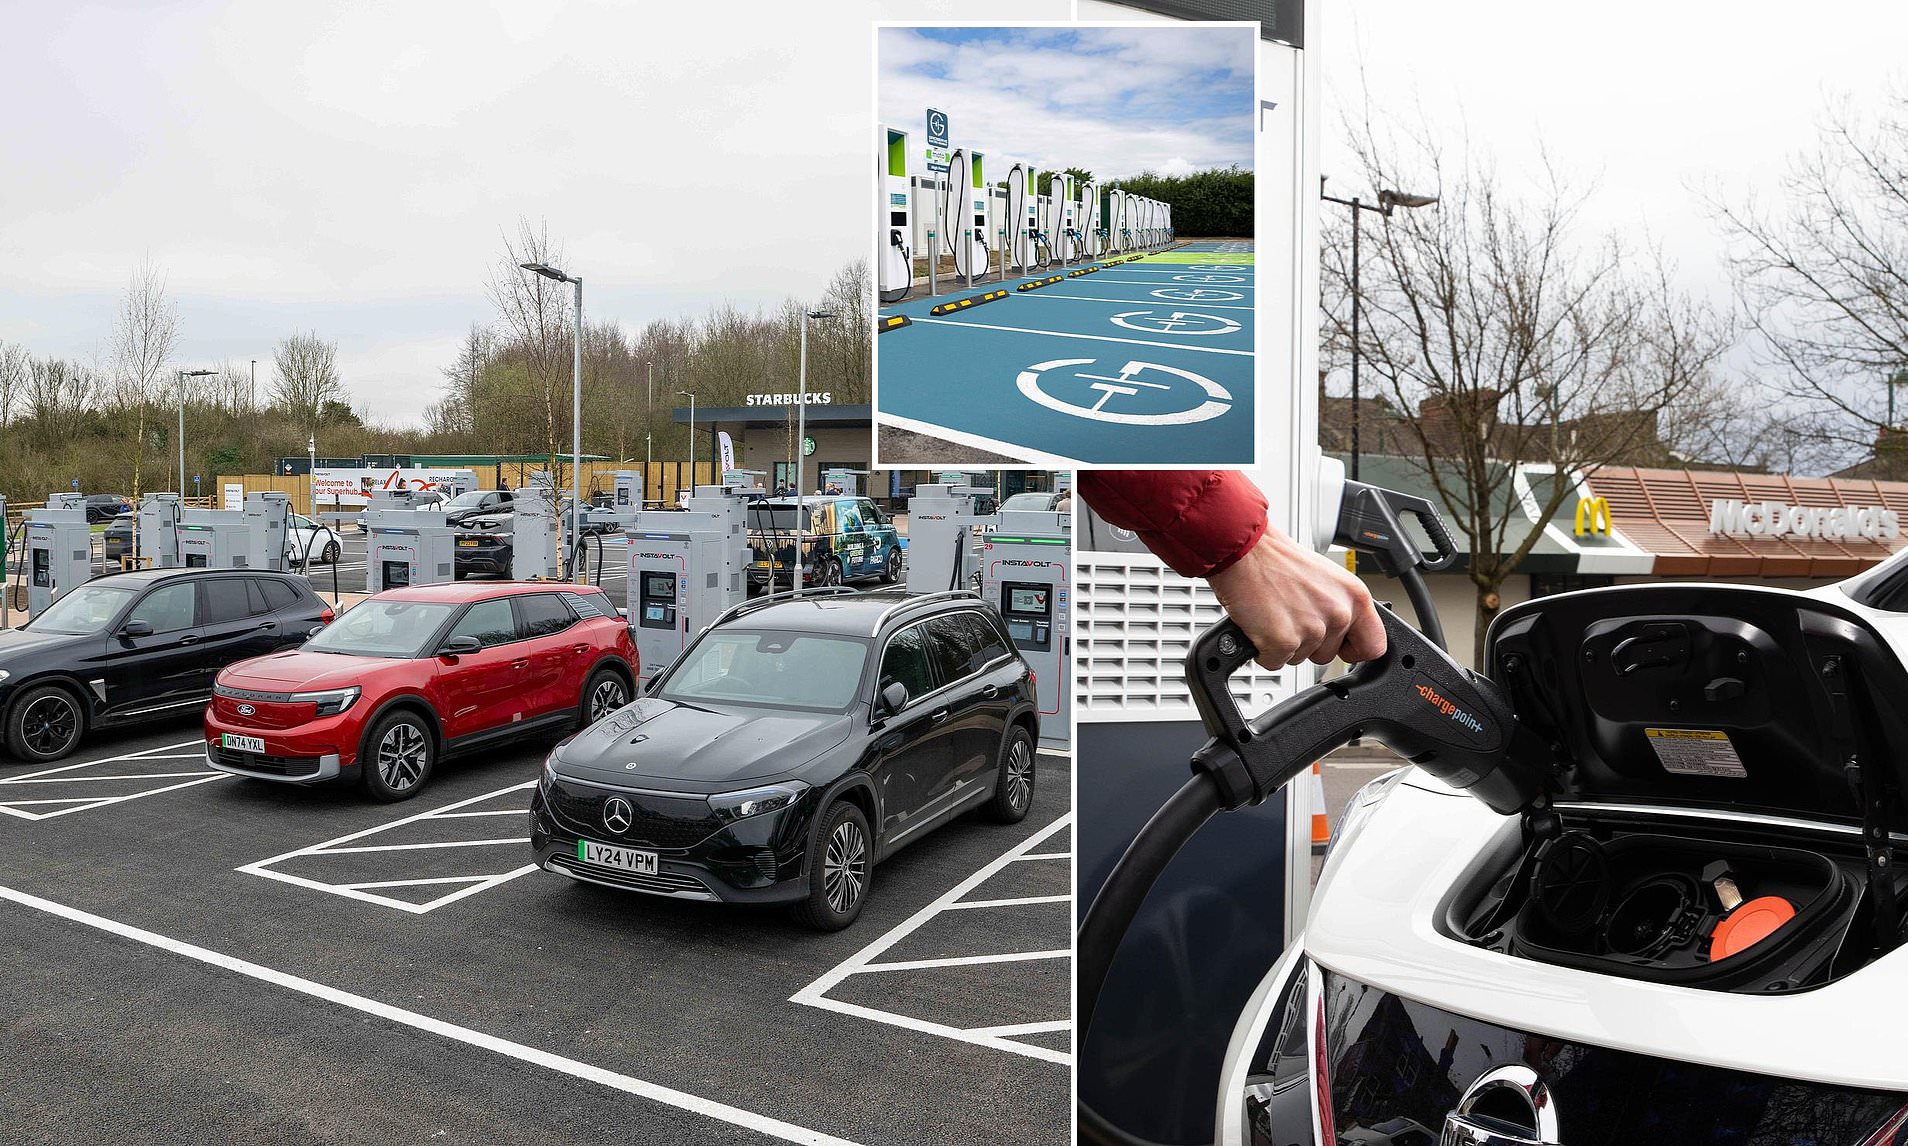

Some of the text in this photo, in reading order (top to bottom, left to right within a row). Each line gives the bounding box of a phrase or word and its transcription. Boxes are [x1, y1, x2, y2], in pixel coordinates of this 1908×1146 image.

[746, 392, 831, 406] STARBUCKS
[315, 479, 354, 488] Welcome to
[428, 476, 454, 484] RECHARG
[984, 543, 993, 551] 29
[1002, 559, 1051, 568] INSTAVOLT
[226, 735, 264, 751] DN74 YXL
[586, 844, 654, 872] LY24 VPM
